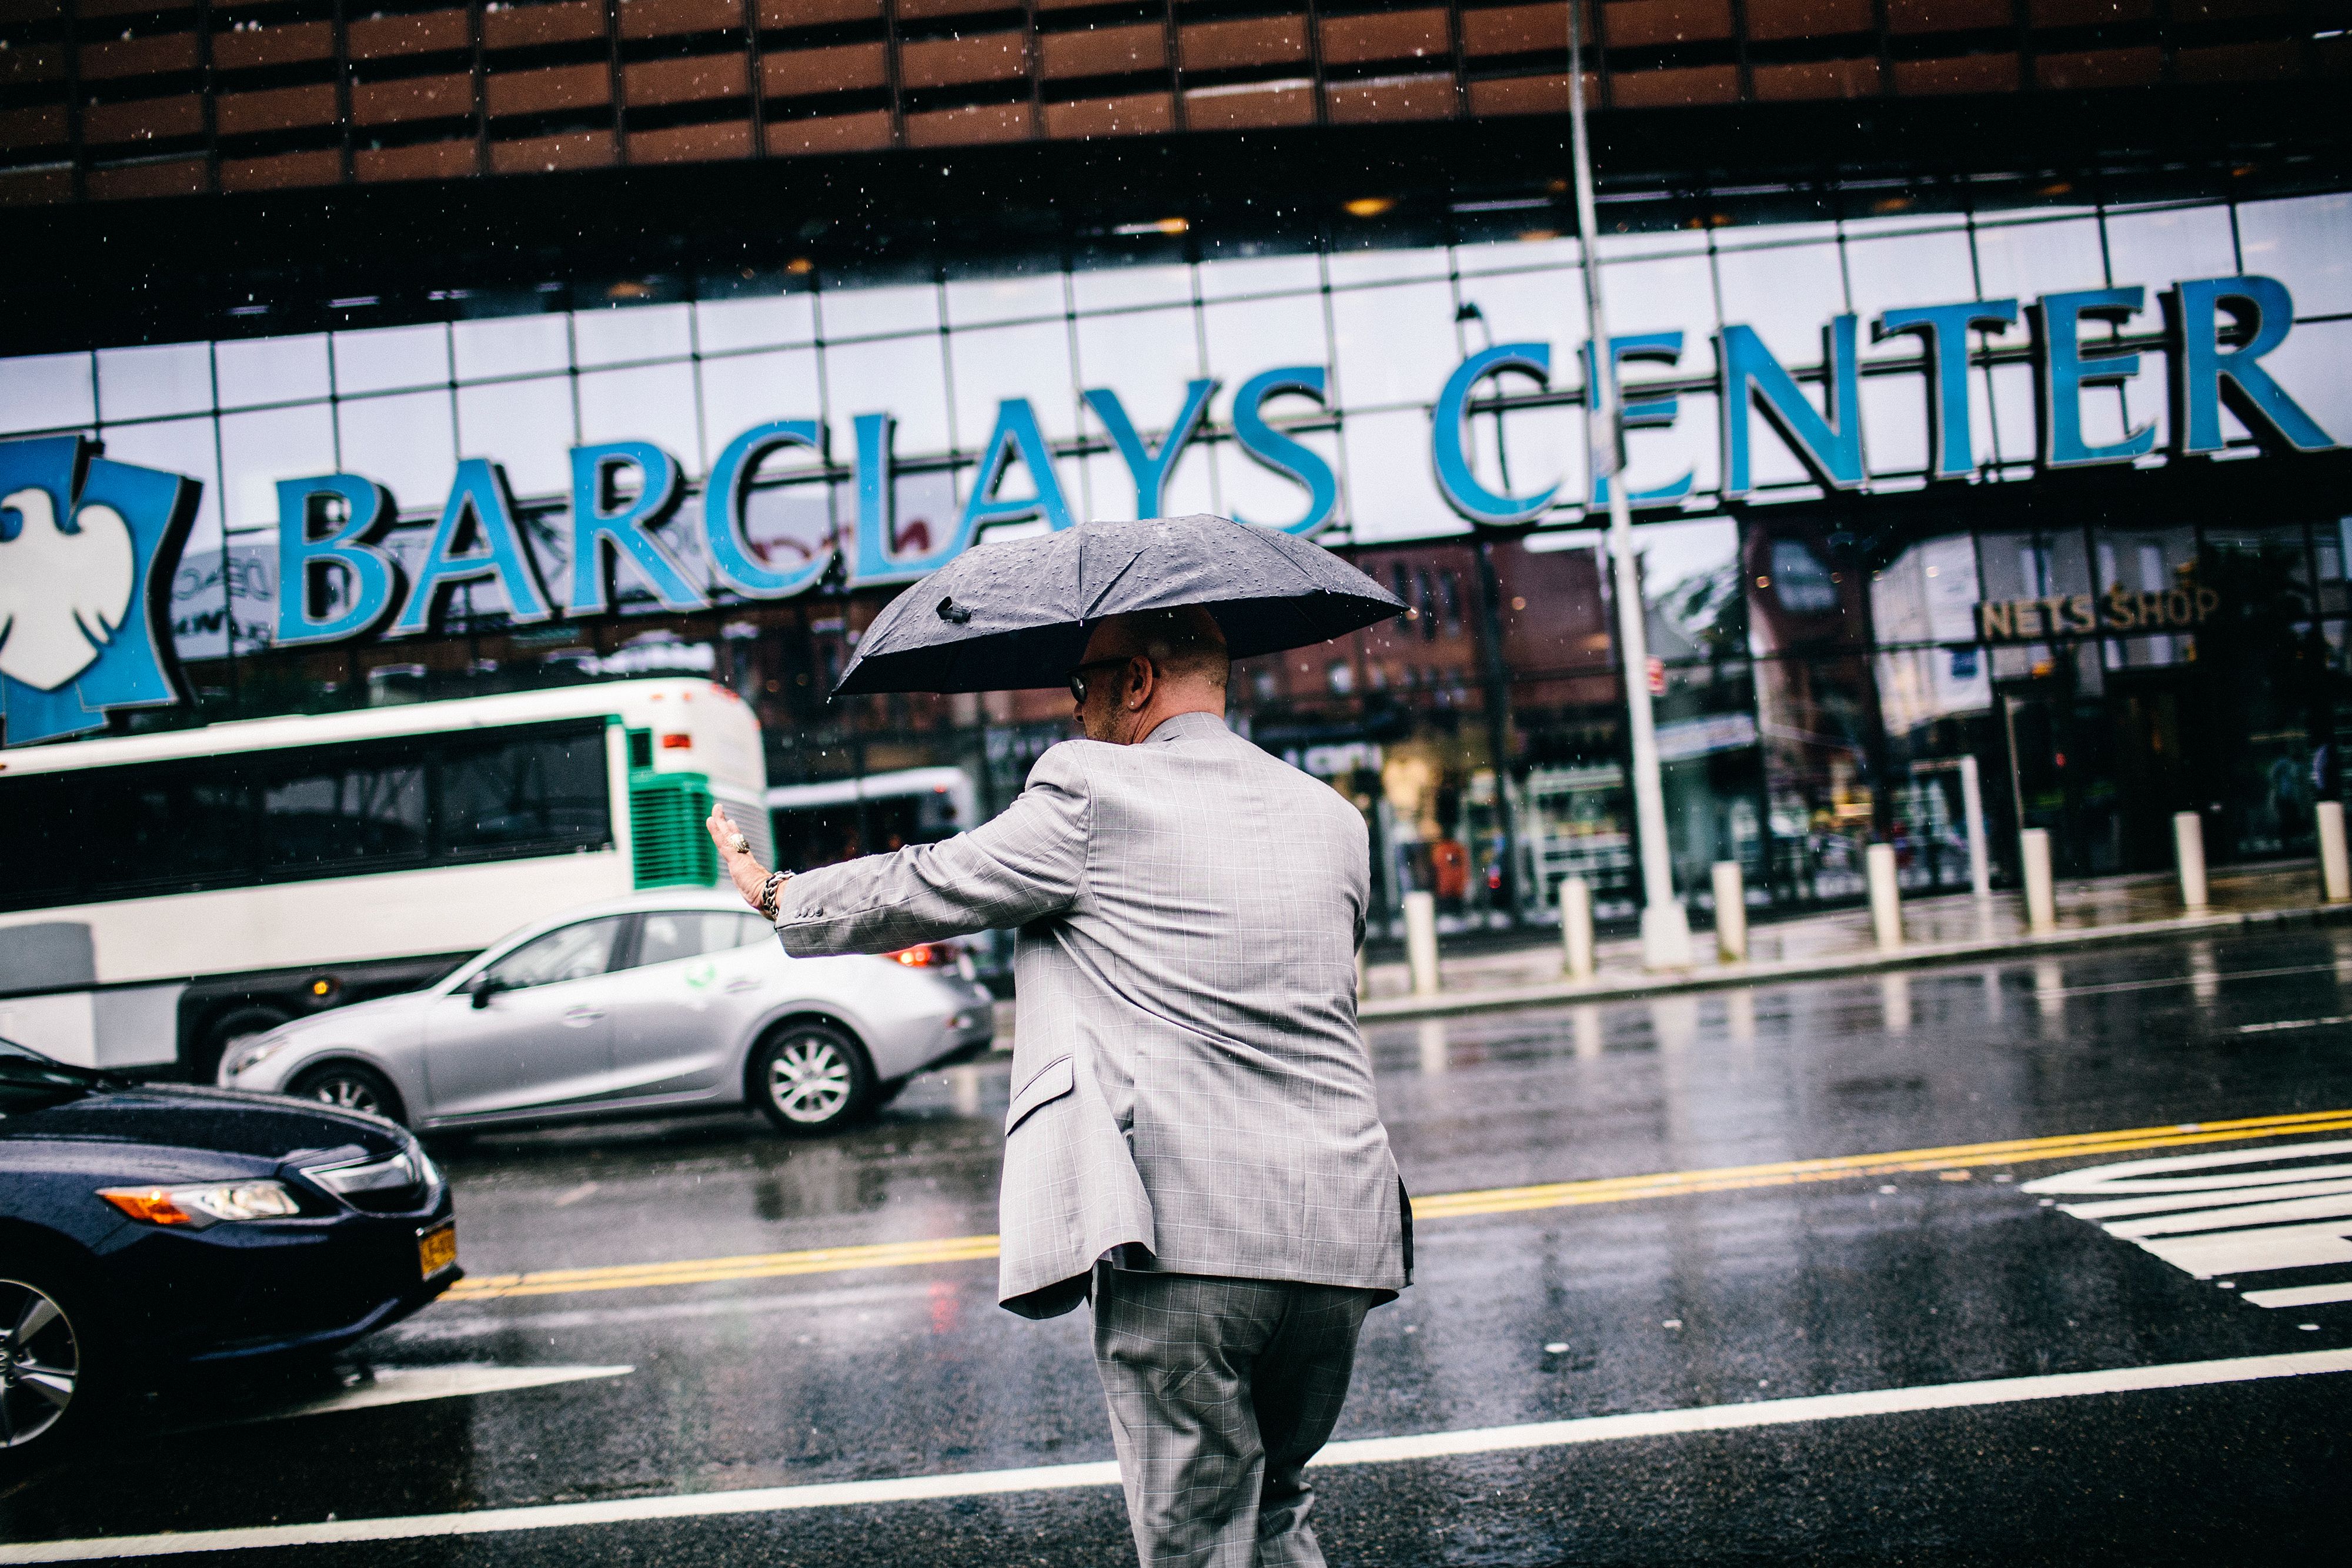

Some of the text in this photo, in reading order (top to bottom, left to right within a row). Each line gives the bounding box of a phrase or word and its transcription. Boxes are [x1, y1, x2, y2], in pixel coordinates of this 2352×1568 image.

[273, 275, 2338, 647] BARCLAYS CENTER
[1982, 587, 2219, 641] NETS SHOP
